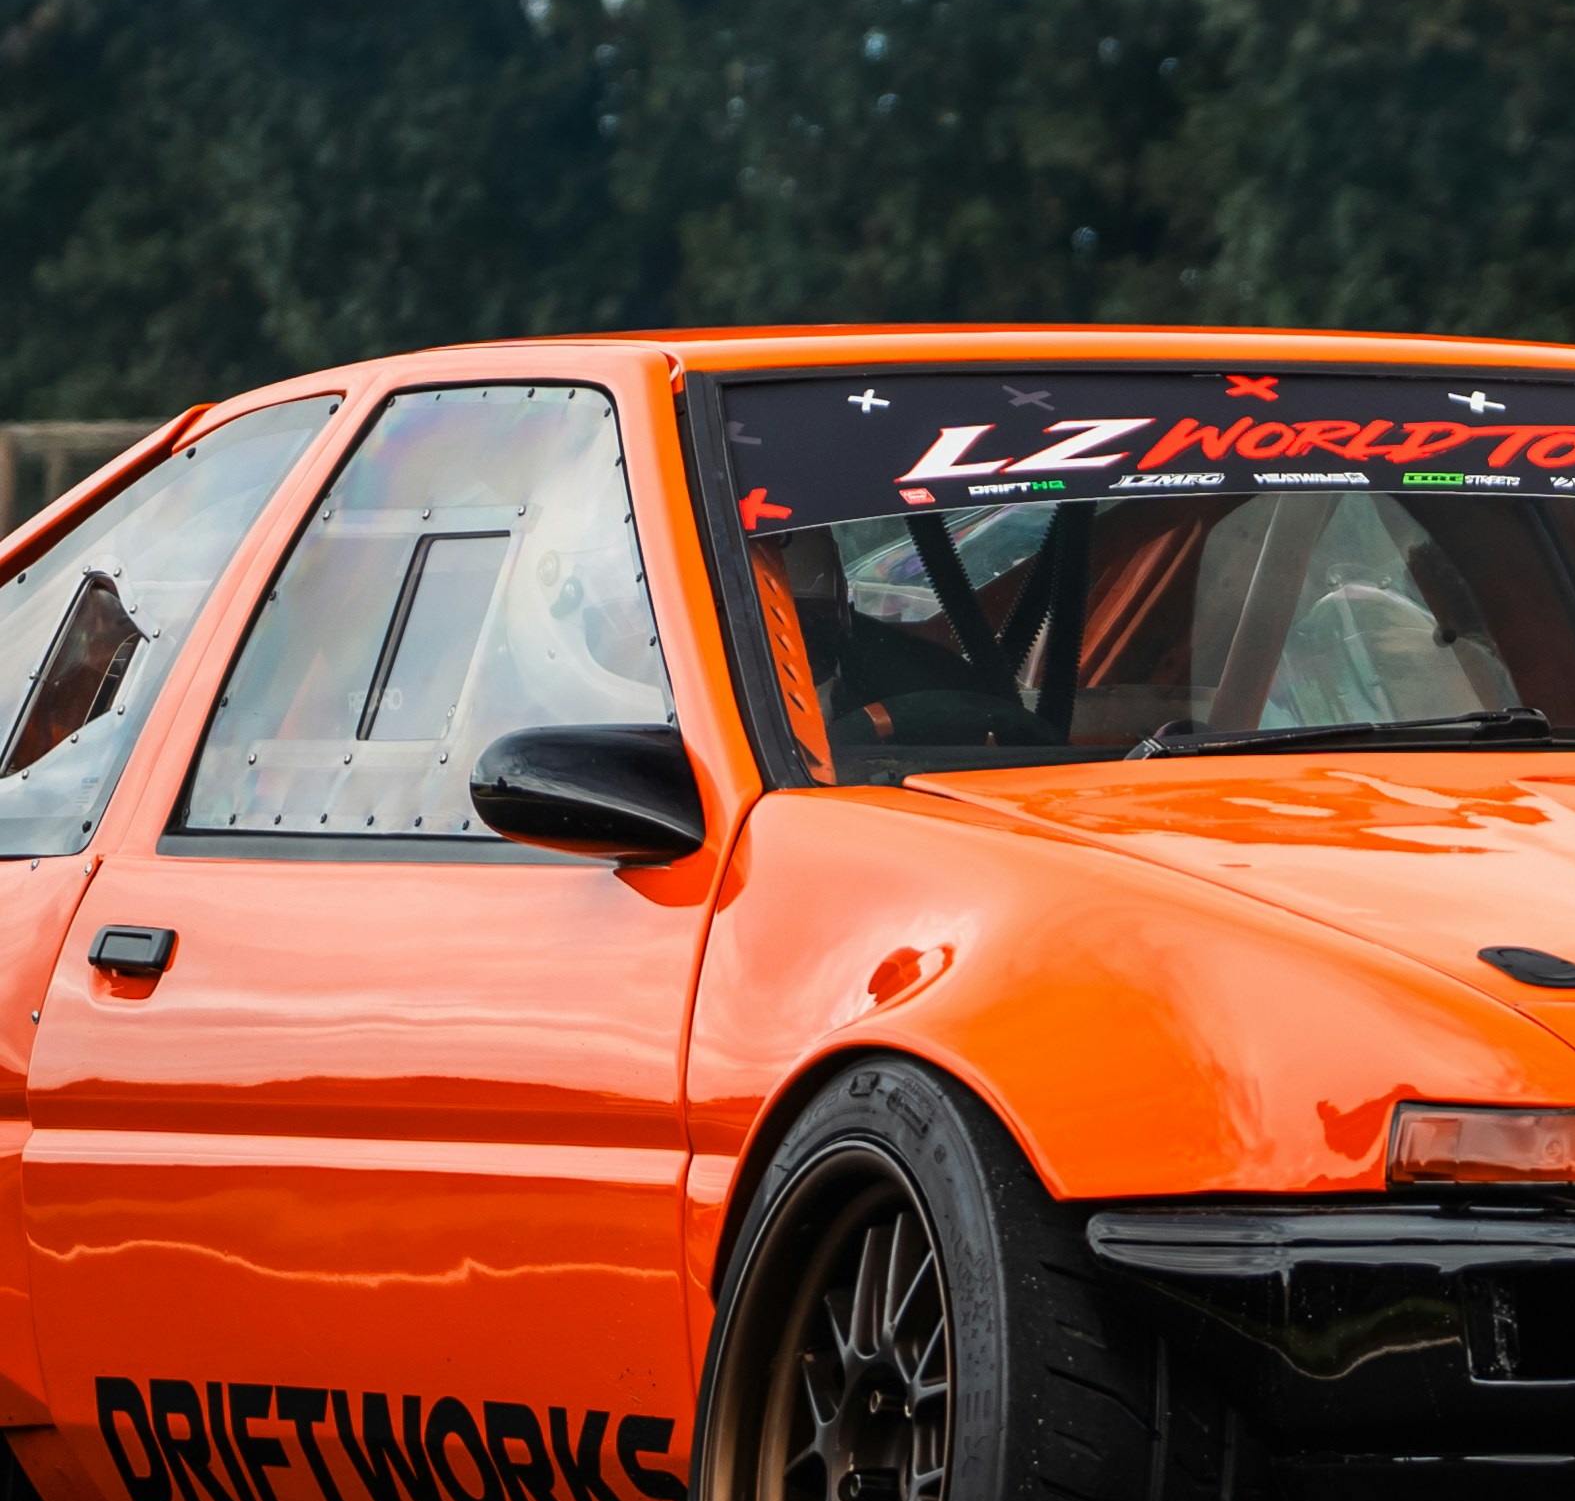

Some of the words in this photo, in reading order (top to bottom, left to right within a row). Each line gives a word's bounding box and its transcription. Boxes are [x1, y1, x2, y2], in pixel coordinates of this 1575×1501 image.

[894, 417, 1156, 483] LZ
[1137, 417, 1474, 470] WORLD
[1110, 473, 1226, 489] LZMFG
